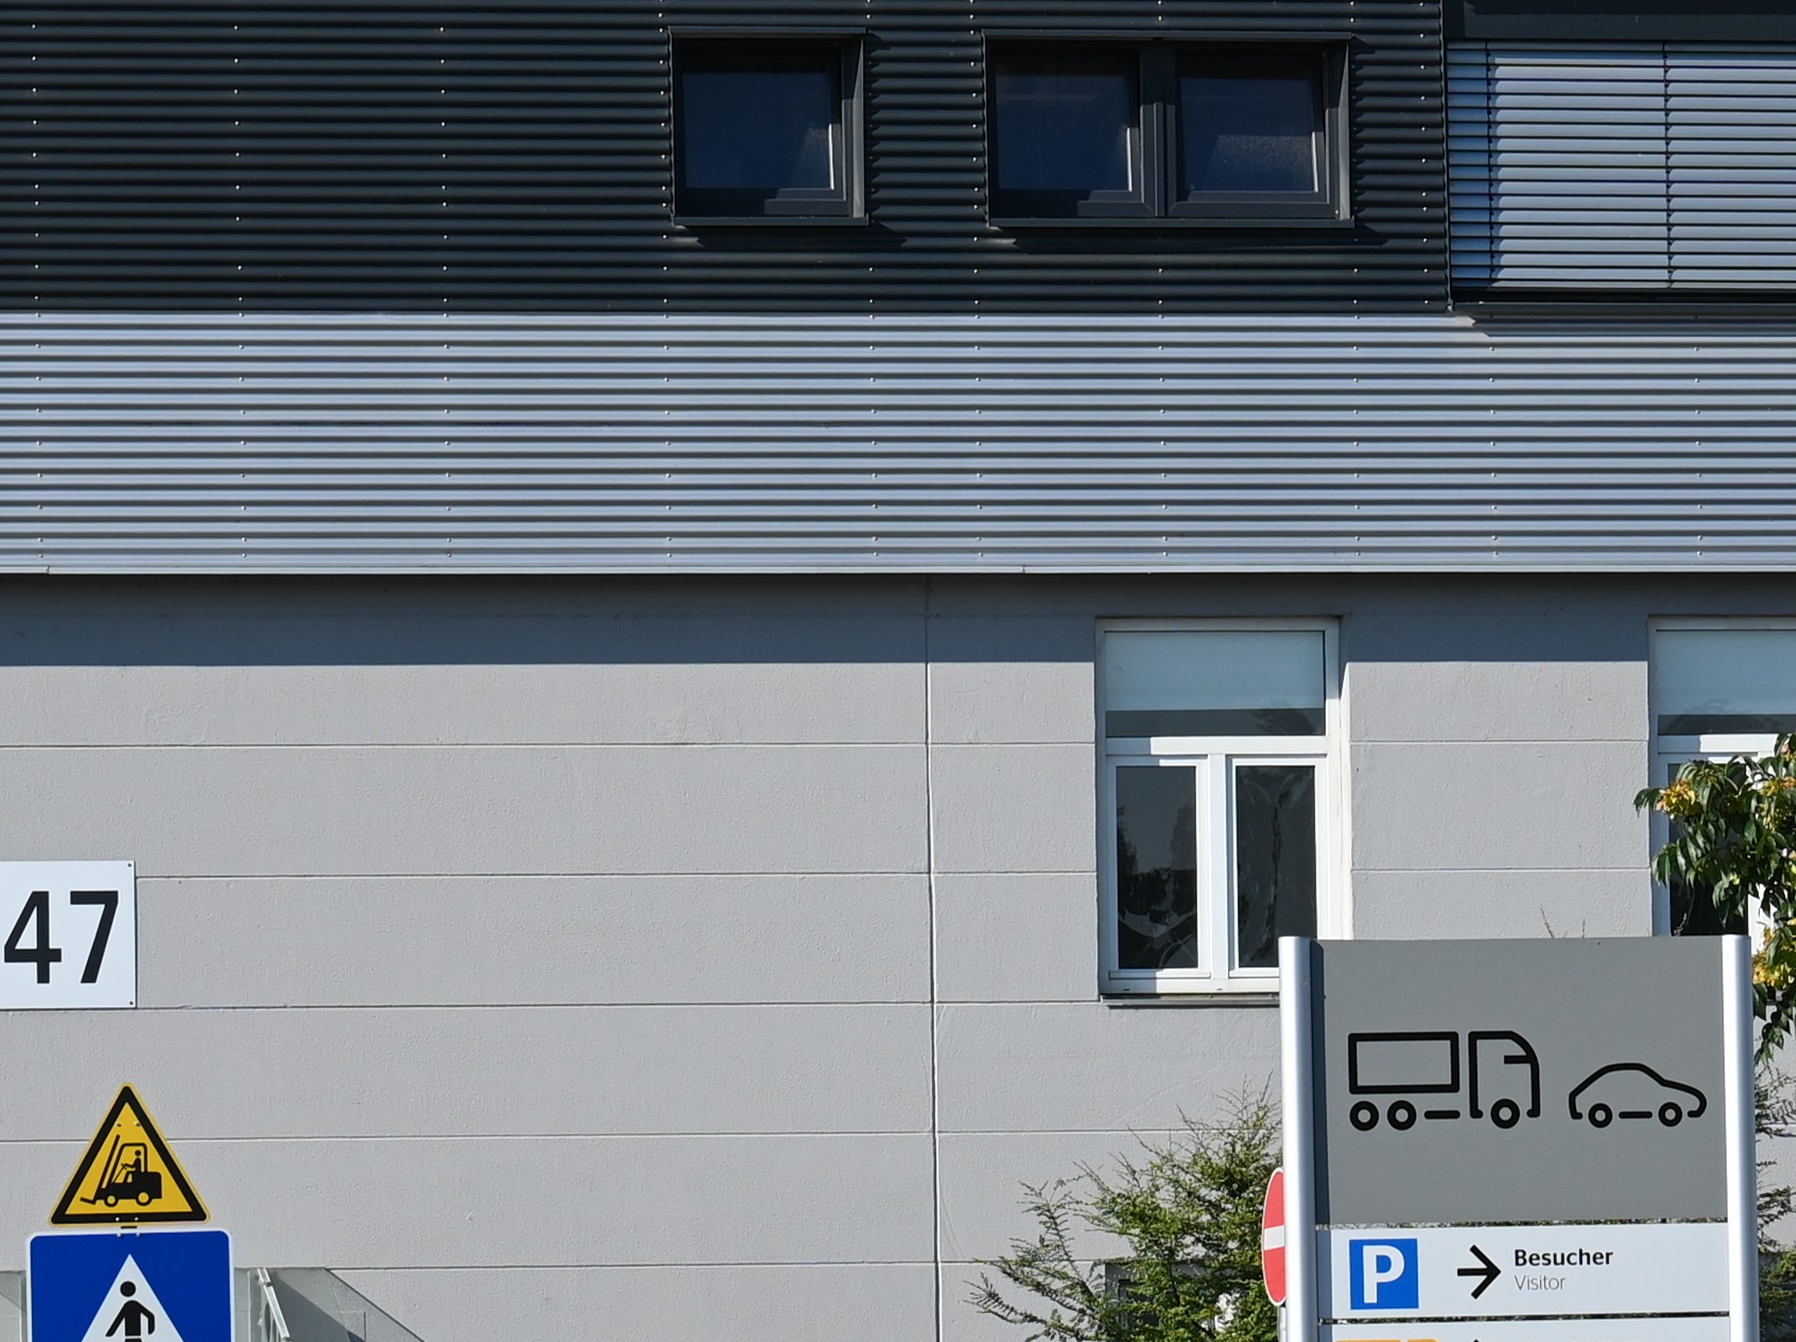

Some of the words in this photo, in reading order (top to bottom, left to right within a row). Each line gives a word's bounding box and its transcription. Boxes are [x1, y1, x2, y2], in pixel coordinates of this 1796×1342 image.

[4, 890, 119, 984] 47
[1362, 1245, 1405, 1304] P
[1514, 1248, 1613, 1267] Besucher
[1514, 1274, 1566, 1291] Visitor
